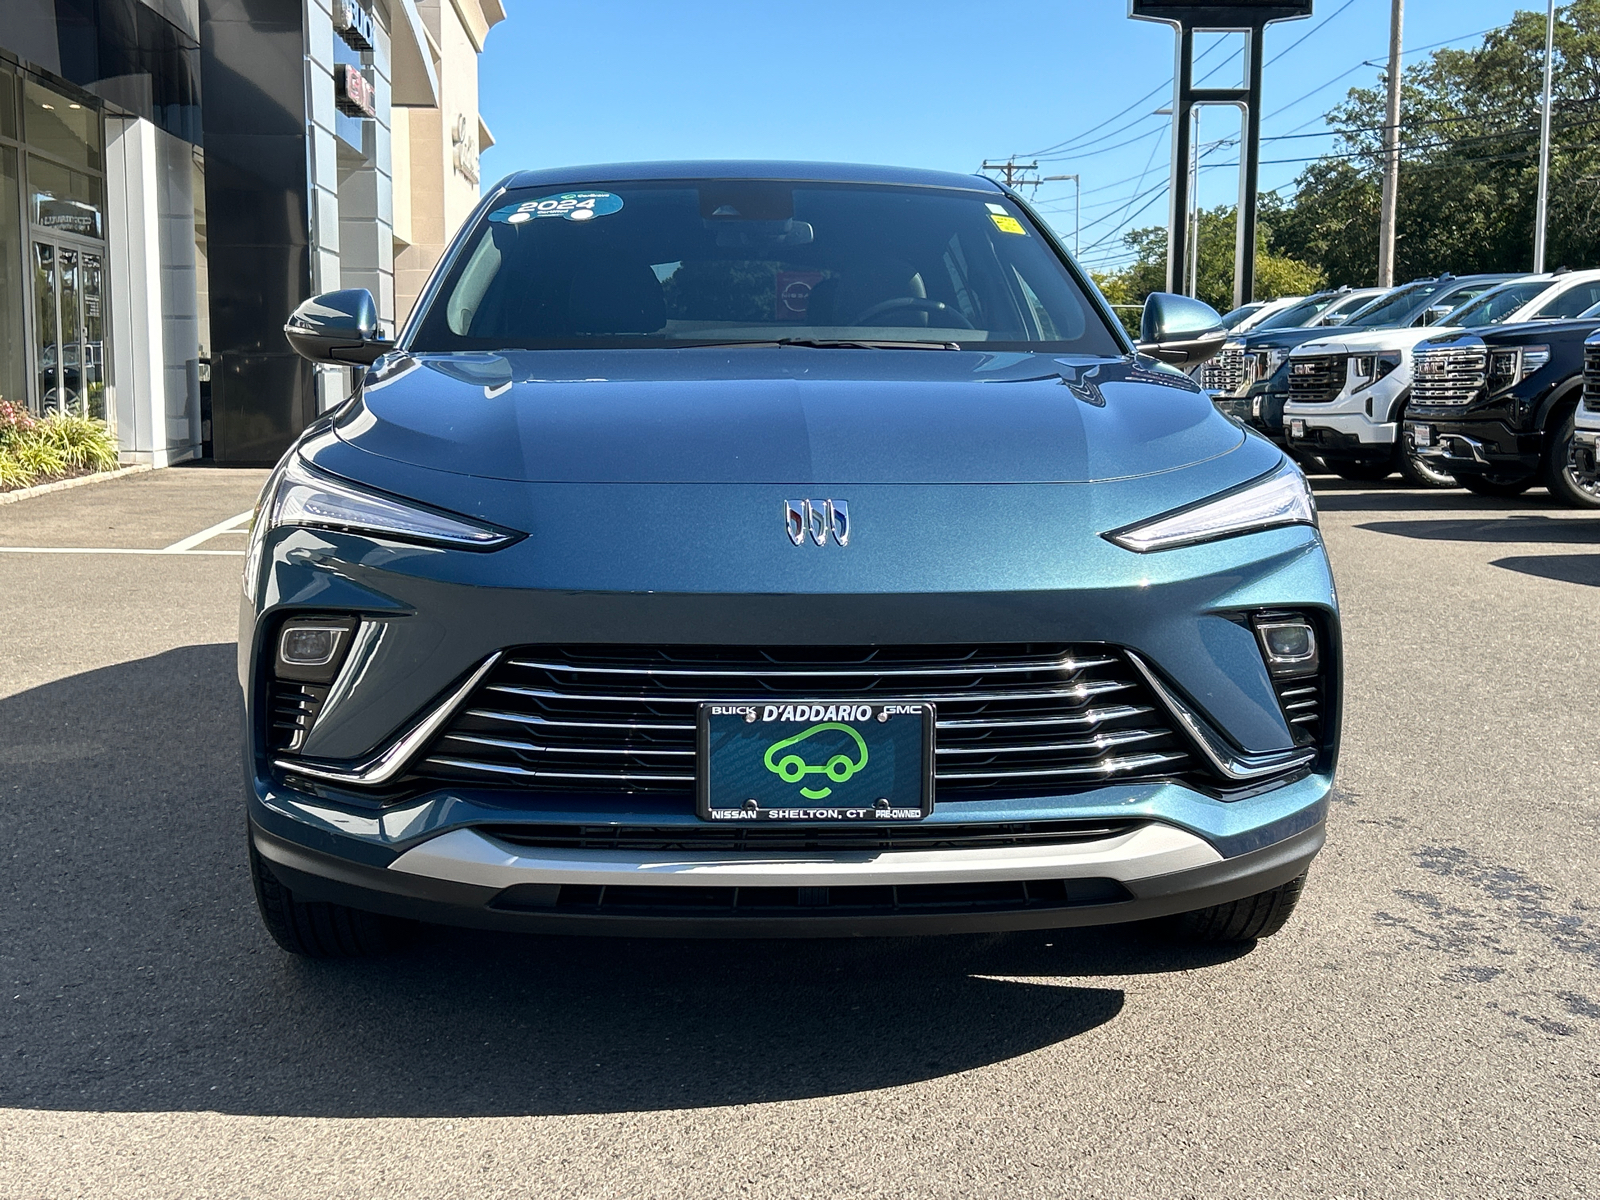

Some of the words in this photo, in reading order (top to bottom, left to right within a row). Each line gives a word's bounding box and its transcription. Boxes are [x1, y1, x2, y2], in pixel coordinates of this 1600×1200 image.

[517, 199, 595, 213] 2024
[711, 706, 757, 715] BUICK
[762, 705, 872, 722] D'ADDARIO
[883, 705, 923, 714] GMC
[711, 810, 757, 819] NISSAN
[768, 809, 843, 819] SHELTON,
[846, 809, 867, 818] CT
[875, 809, 921, 818] PRE-OWNED
